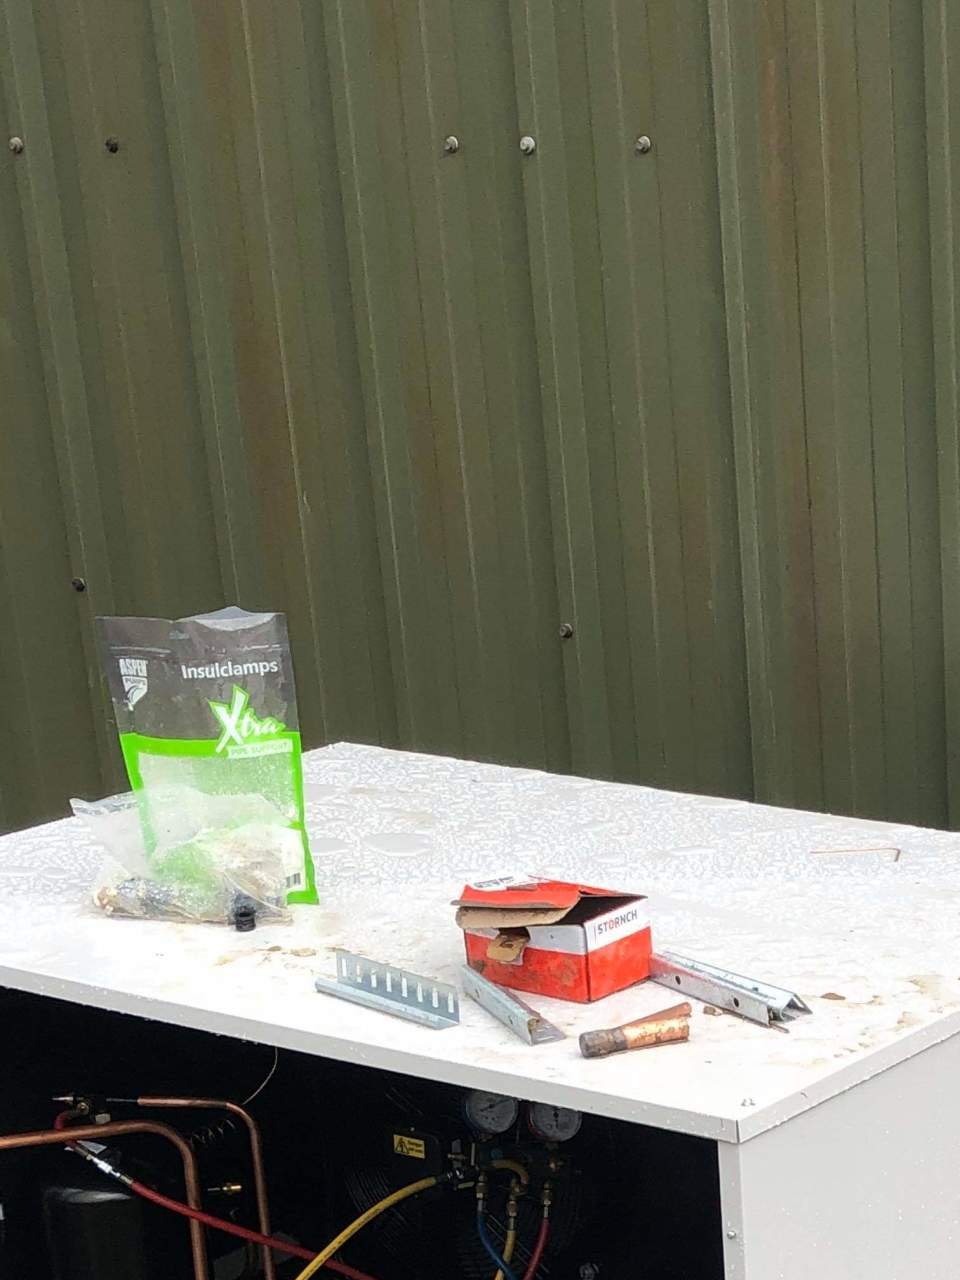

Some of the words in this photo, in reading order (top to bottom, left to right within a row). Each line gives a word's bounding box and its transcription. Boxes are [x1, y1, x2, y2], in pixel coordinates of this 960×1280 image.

[119, 658, 148, 676] ASPEN
[181, 661, 279, 678] Insulclamps
[211, 687, 284, 753] Xtra
